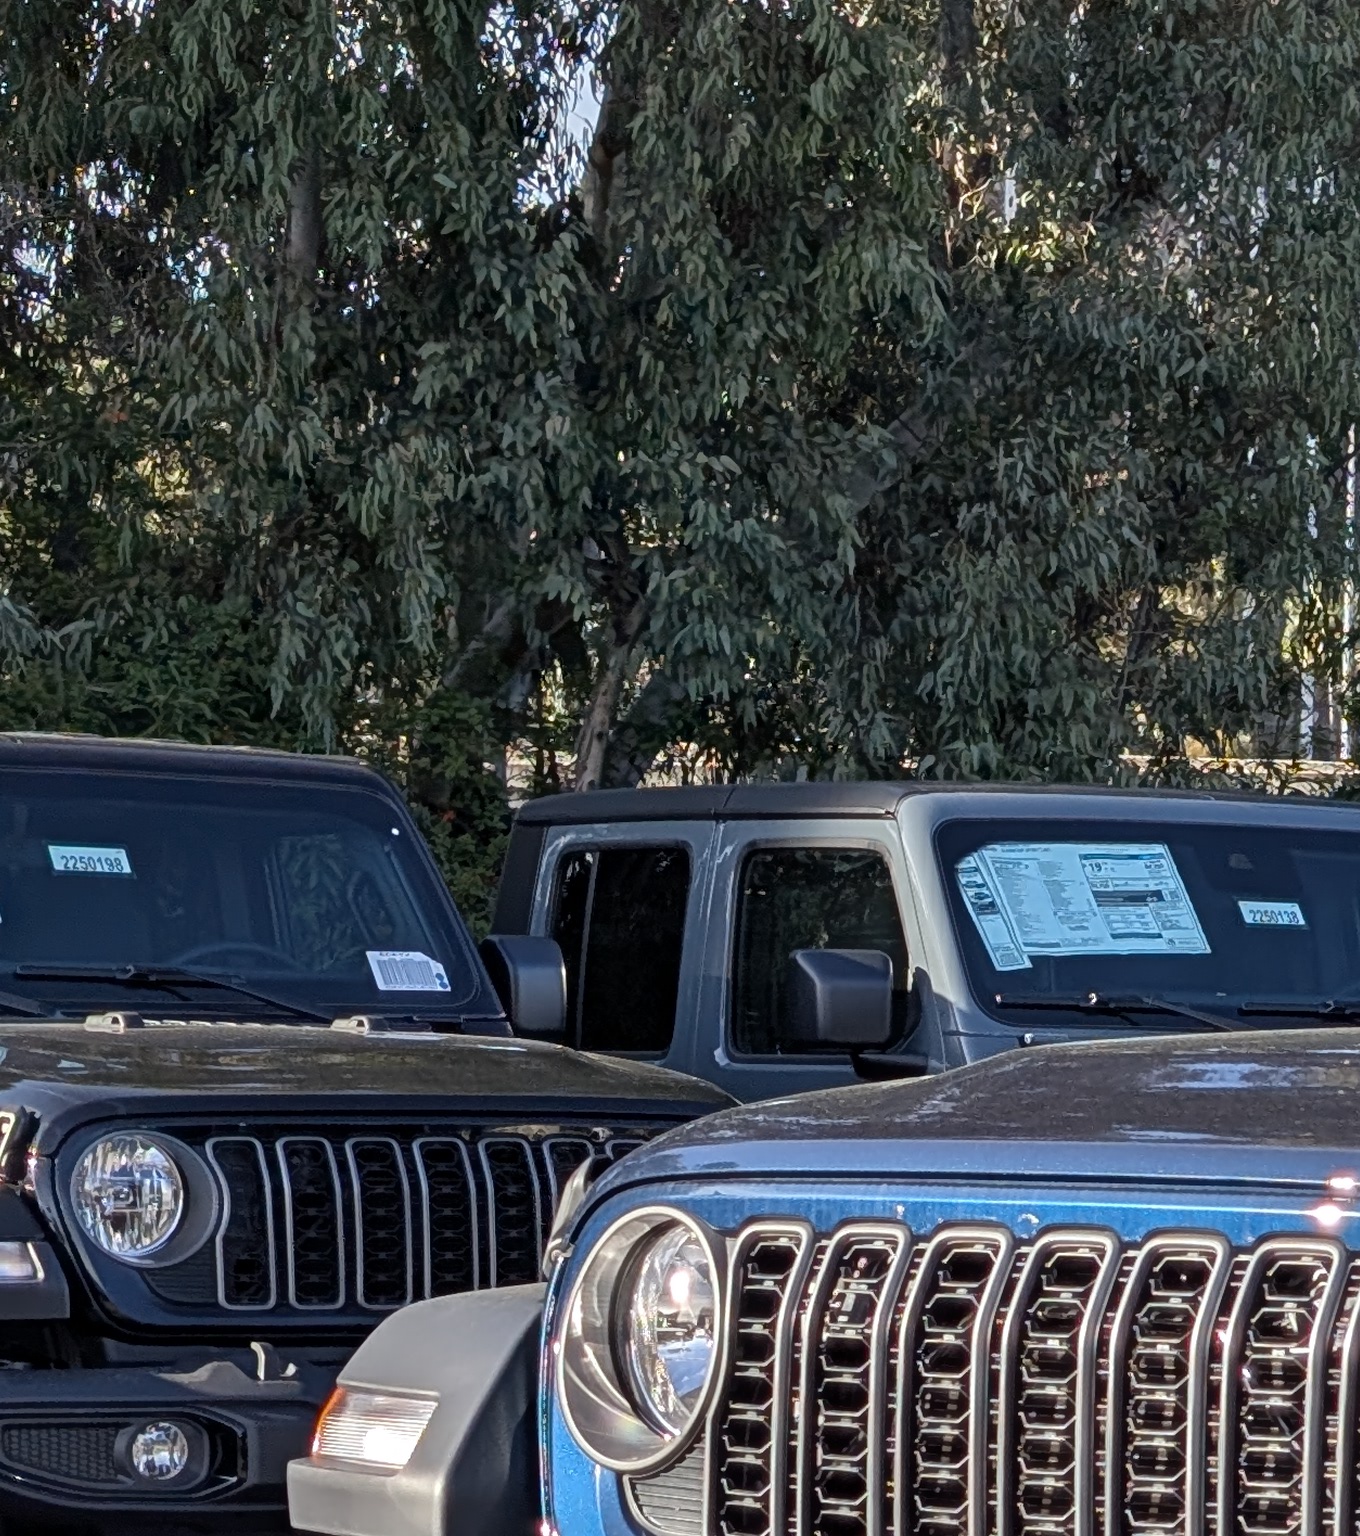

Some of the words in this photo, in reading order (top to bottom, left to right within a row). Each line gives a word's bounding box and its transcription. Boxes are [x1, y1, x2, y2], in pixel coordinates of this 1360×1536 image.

[60, 855, 124, 872] 2250198
[1088, 861, 1102, 873] 19
[1249, 909, 1300, 924] 2250138
